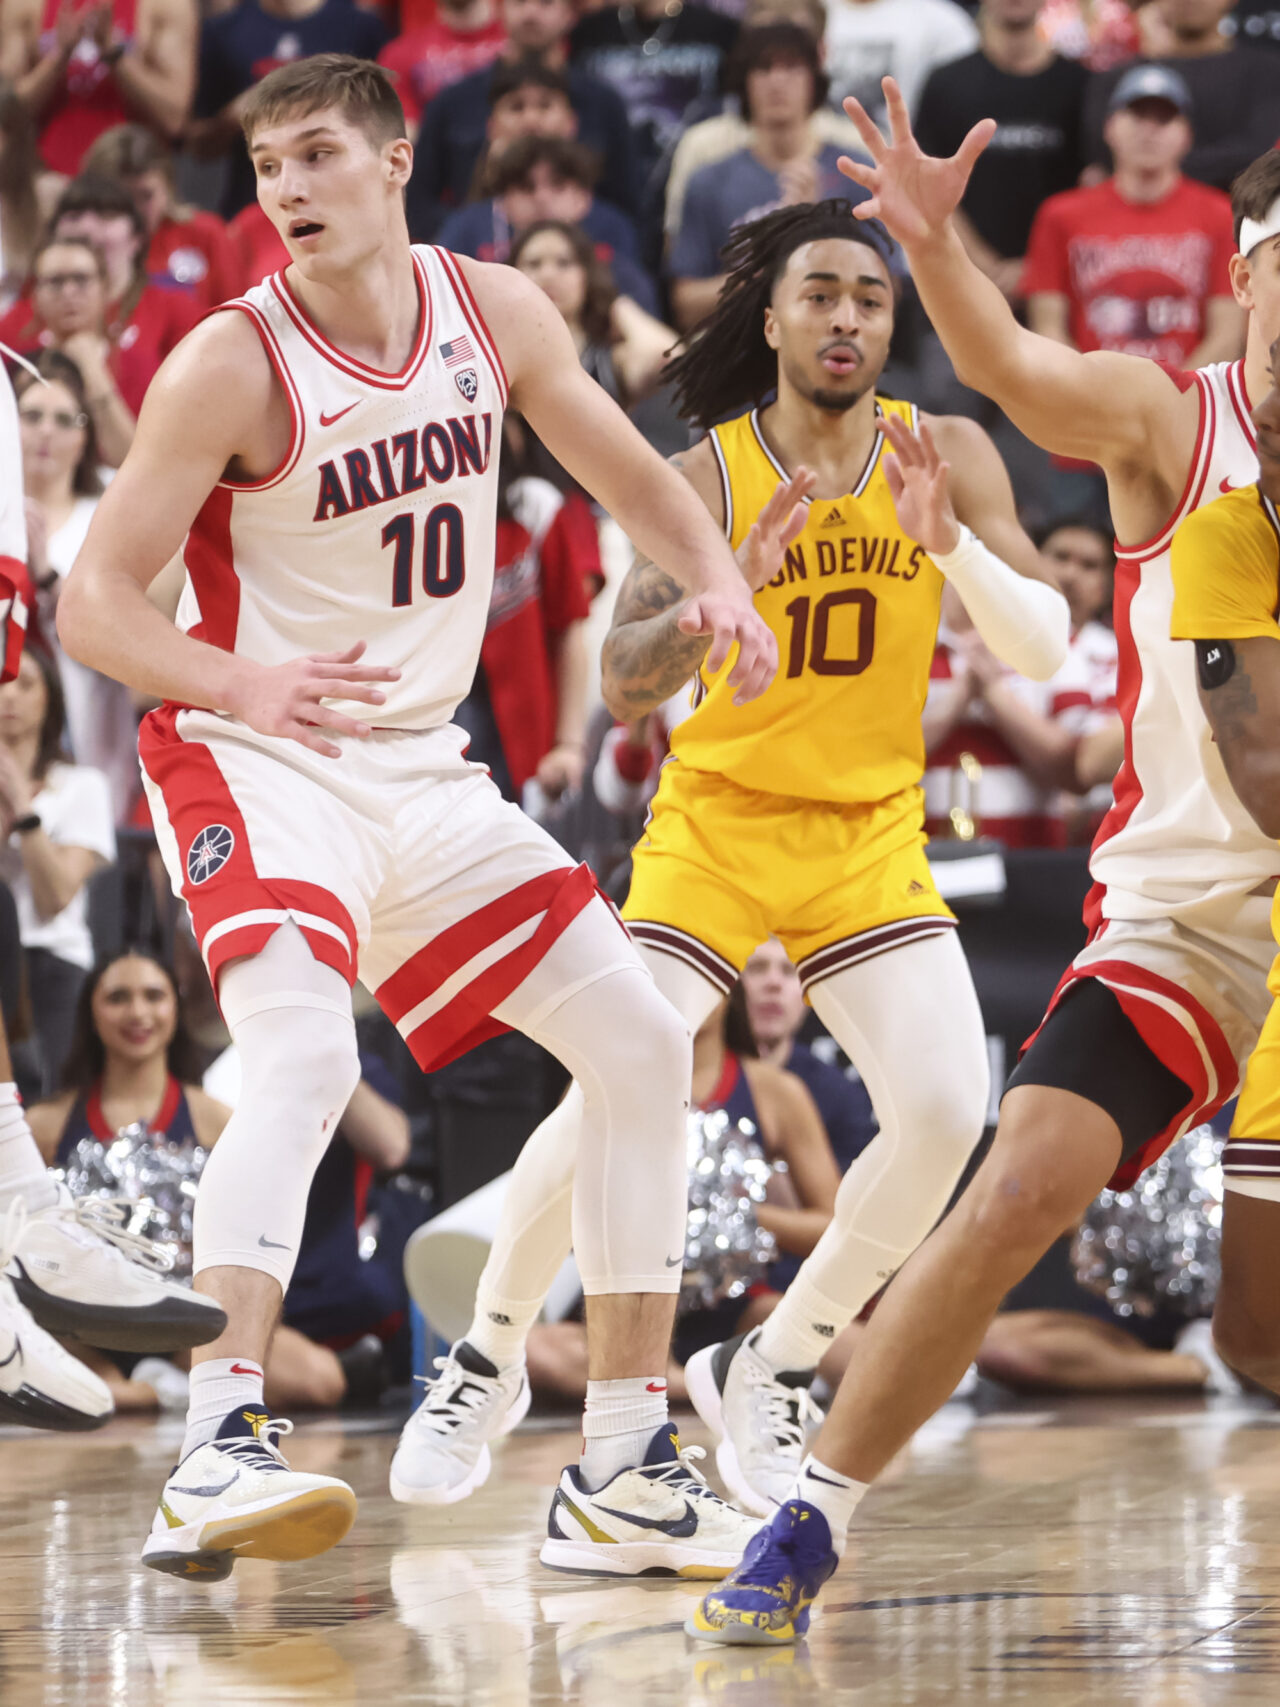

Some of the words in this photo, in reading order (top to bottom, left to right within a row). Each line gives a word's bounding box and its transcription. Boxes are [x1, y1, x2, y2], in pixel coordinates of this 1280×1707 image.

[381, 502, 466, 607] 10
[816, 536, 926, 581] DEVILS
[785, 588, 877, 679] 10
